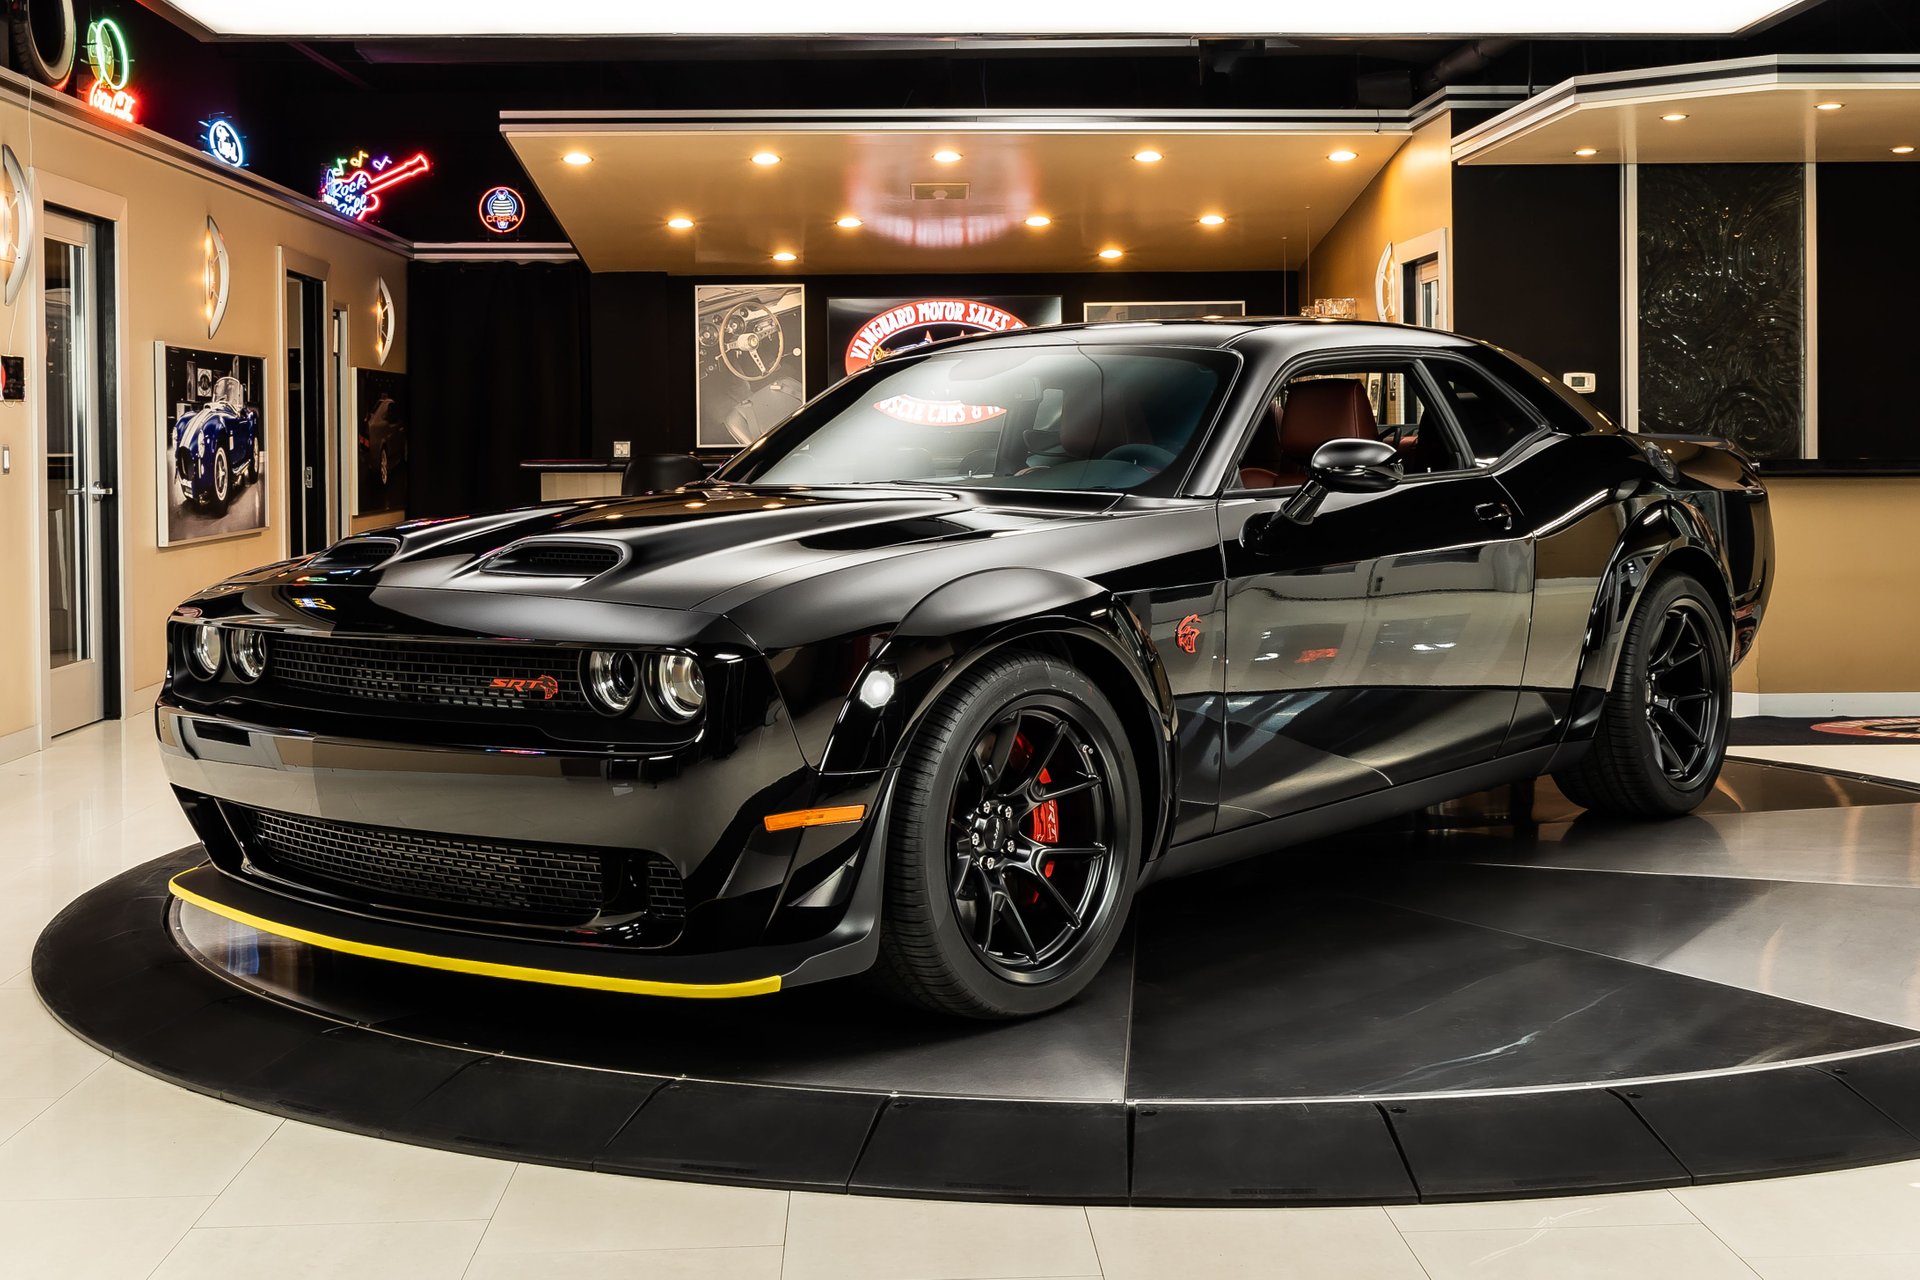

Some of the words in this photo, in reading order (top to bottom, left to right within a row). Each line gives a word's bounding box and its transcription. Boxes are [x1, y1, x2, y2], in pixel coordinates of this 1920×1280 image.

[332, 173, 367, 198] Rock
[486, 214, 519, 223] COBRA
[850, 306, 916, 360] VANGUARD
[916, 301, 965, 322] MOTOR
[966, 303, 1010, 331] SALES
[927, 402, 966, 423] CARS
[489, 678, 543, 692] SRT
